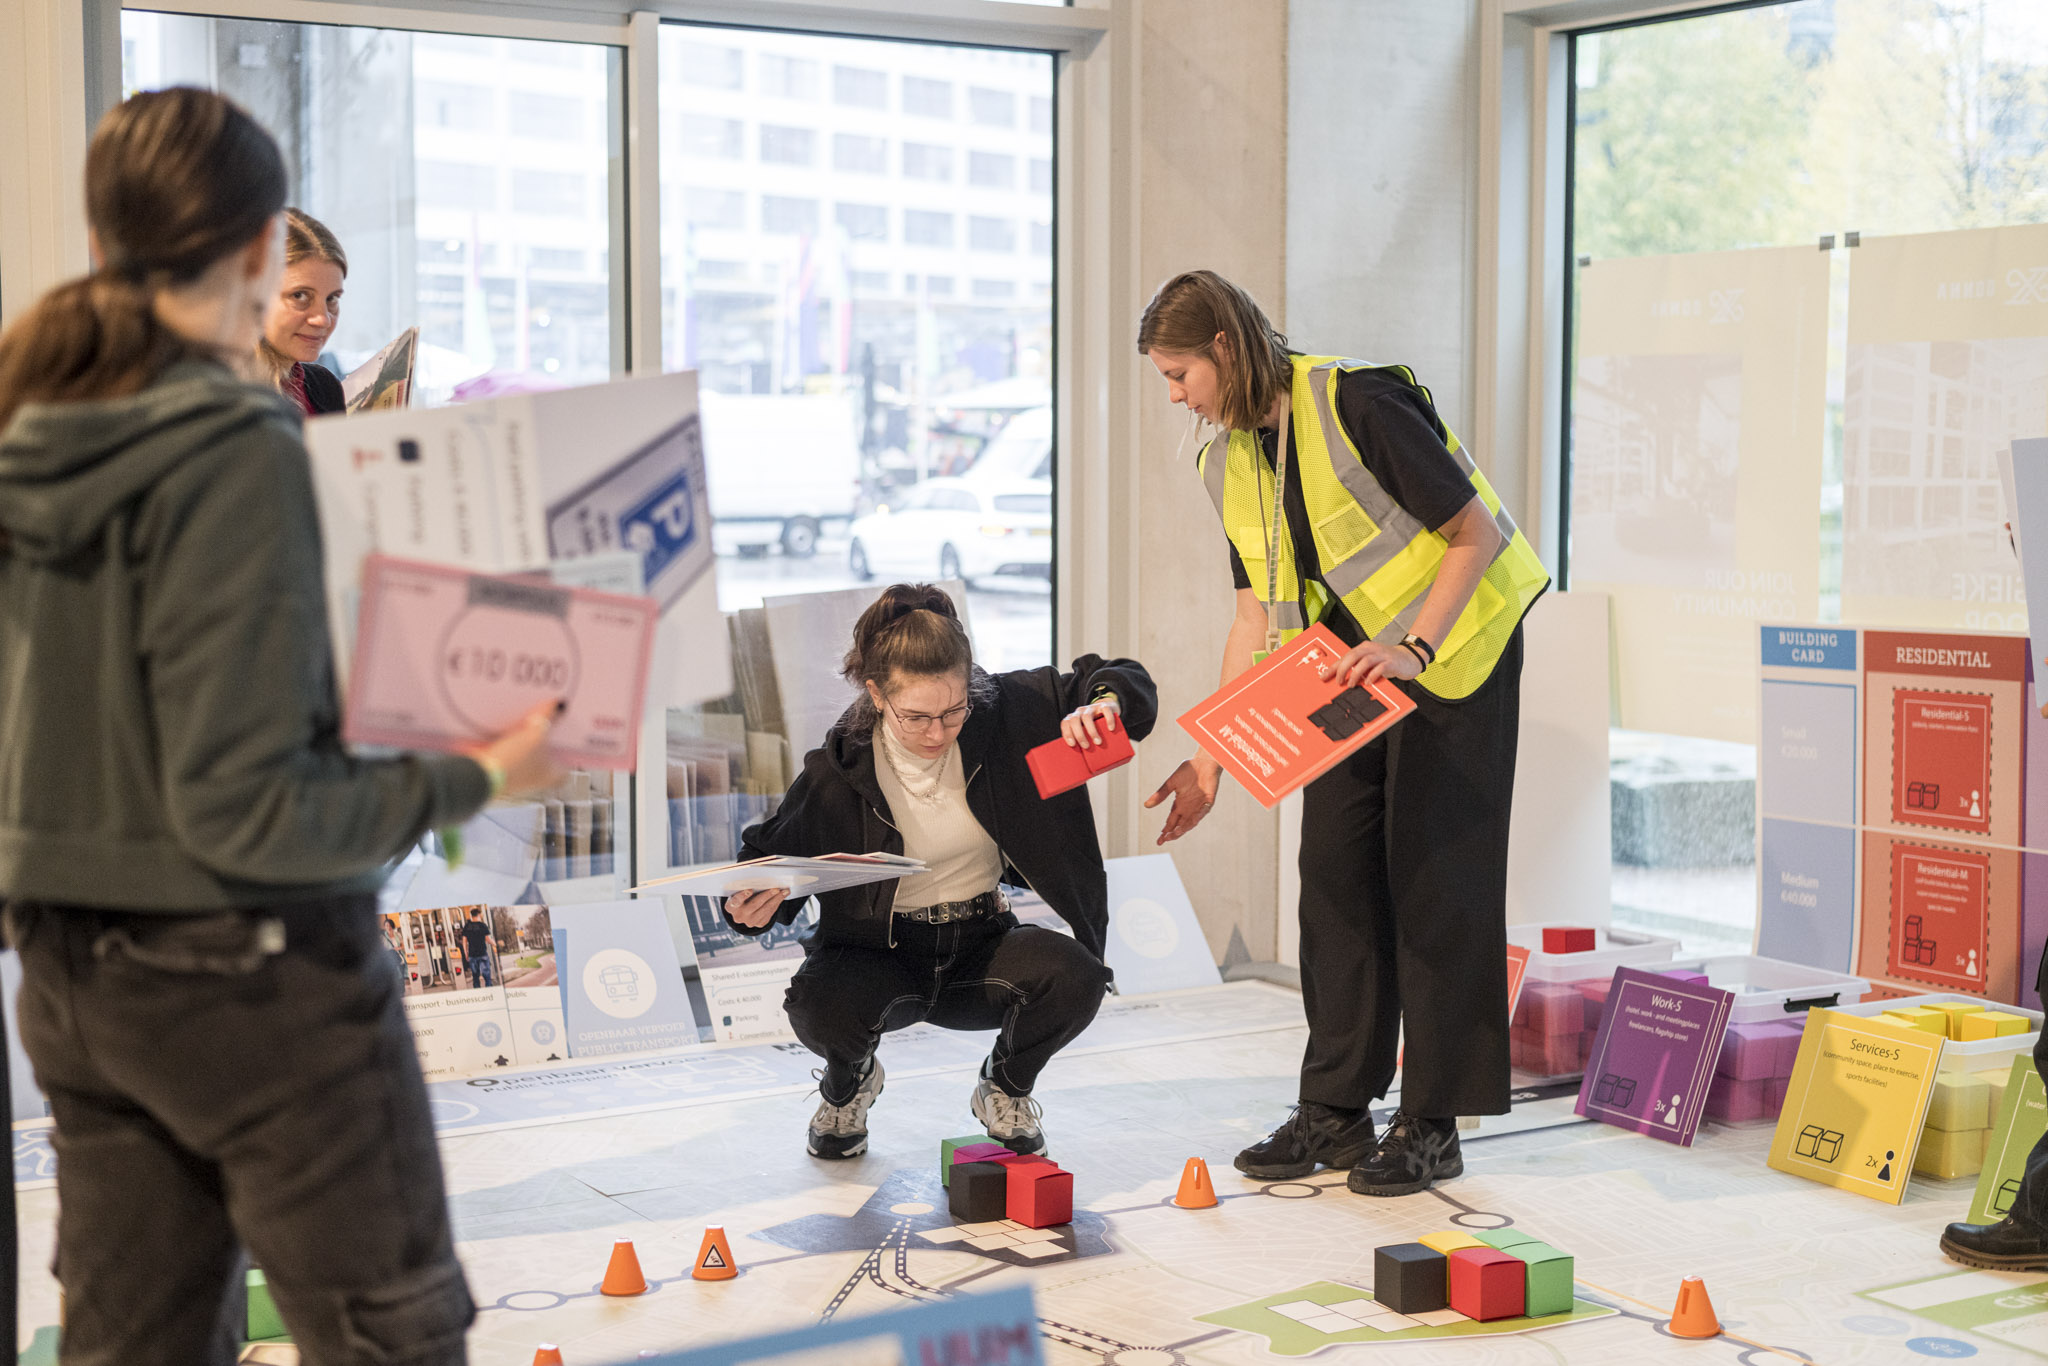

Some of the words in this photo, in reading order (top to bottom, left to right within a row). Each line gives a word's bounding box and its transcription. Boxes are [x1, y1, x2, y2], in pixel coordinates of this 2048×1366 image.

[1779, 631, 1838, 647] BUILDING
[1792, 648, 1825, 663] CARD
[1896, 646, 1991, 668] RESIDENTIAL
[1921, 706, 1969, 722] Residential-S
[1219, 724, 1275, 778] Residential-M
[1781, 871, 1819, 889] Medium
[1917, 862, 1968, 880] Residential-M
[712, 972, 735, 981] Shared
[404, 1001, 440, 1012] transport
[446, 994, 494, 1007] businesscard
[506, 990, 528, 999] public
[1651, 994, 1683, 1012] Work-S
[578, 1028, 638, 1042] OPENBAAR
[638, 1021, 685, 1035] VERVOER
[578, 1042, 621, 1057] PUBLIC
[623, 1034, 696, 1051] TRANSPORT
[1850, 1038, 1900, 1061] Services-S
[1823, 1050, 1855, 1064] (community
[1873, 1062, 1889, 1073] place
[1889, 1066, 1896, 1074] to
[466, 1067, 608, 1088] Openbaar
[615, 1056, 710, 1071] vervoer
[1846, 1072, 1863, 1082] sports
[483, 1081, 537, 1093] Public
[538, 1073, 621, 1089] transport
[1654, 1099, 1667, 1113] 3x
[1865, 1154, 1879, 1169] 2x
